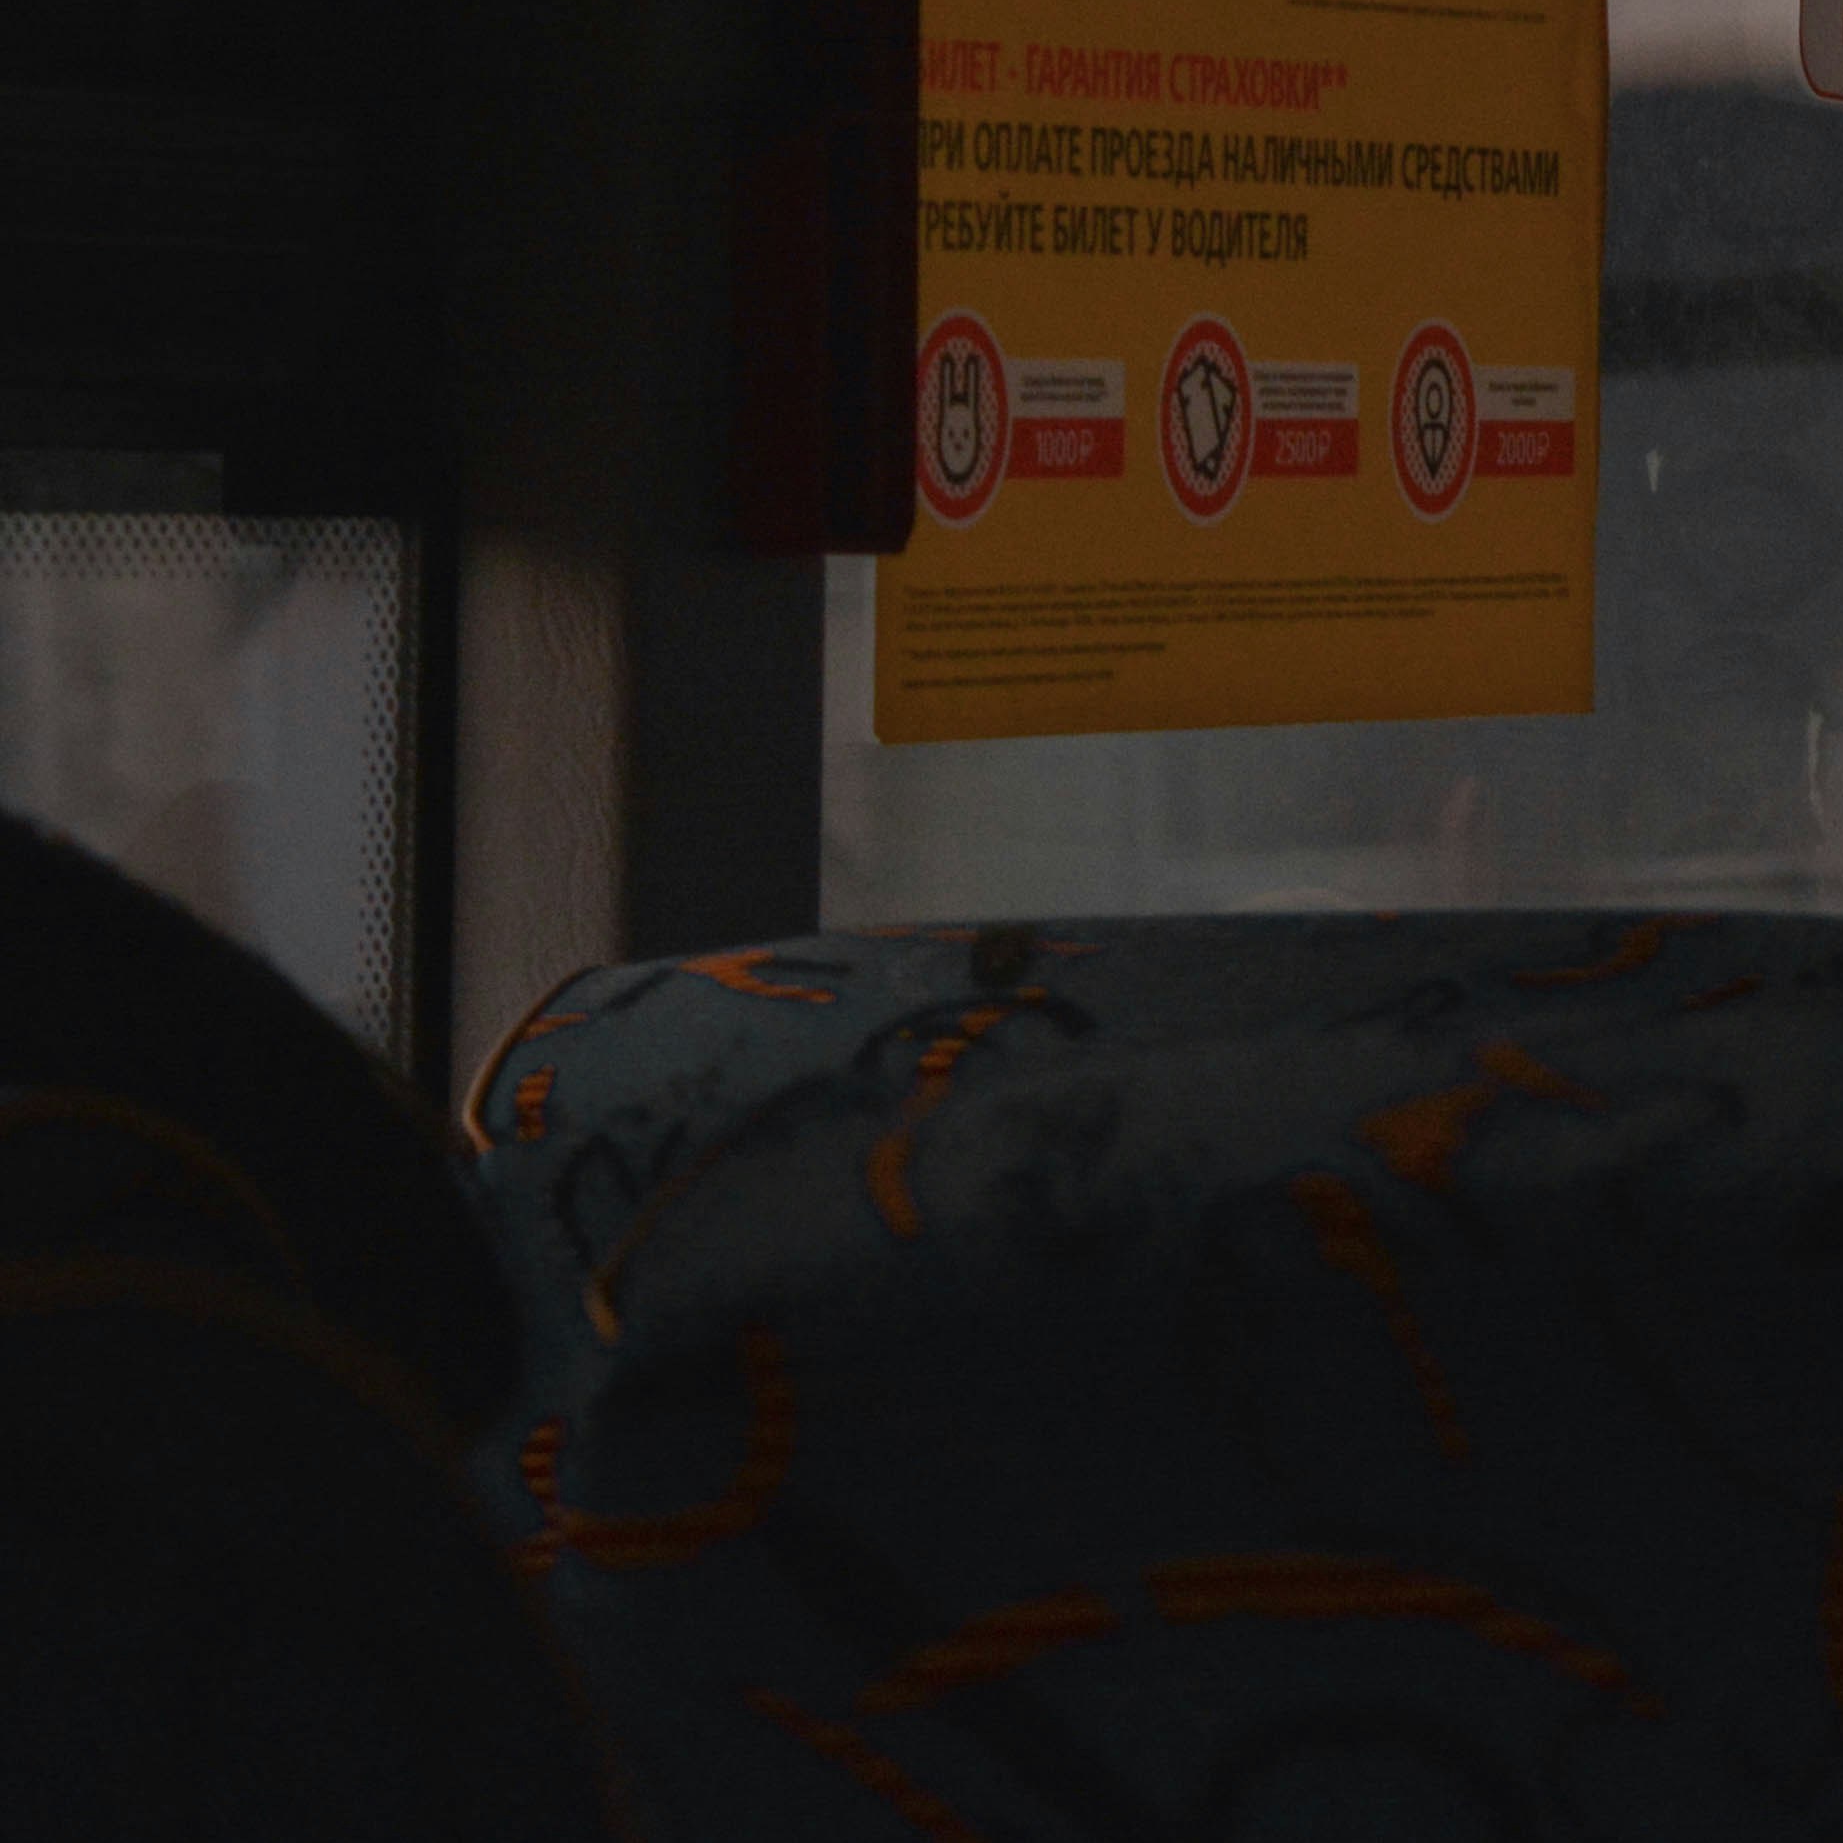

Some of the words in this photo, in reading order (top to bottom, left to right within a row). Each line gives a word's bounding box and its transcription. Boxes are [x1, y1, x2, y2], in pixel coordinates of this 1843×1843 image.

[1026, 44, 1161, 102] ГАРАНТИЯ
[974, 121, 1082, 177] ОПЛАТЕ
[1091, 127, 1215, 188] ПРОЕЗДА
[1223, 134, 1394, 189] НАЛИЧНЫМИ
[1402, 142, 1560, 201] СРЕДСТВАМИ
[1054, 203, 1138, 256] БИЛЕТ
[1146, 208, 1166, 257] У
[1172, 211, 1308, 267] ВОДИТЕЛЯ
